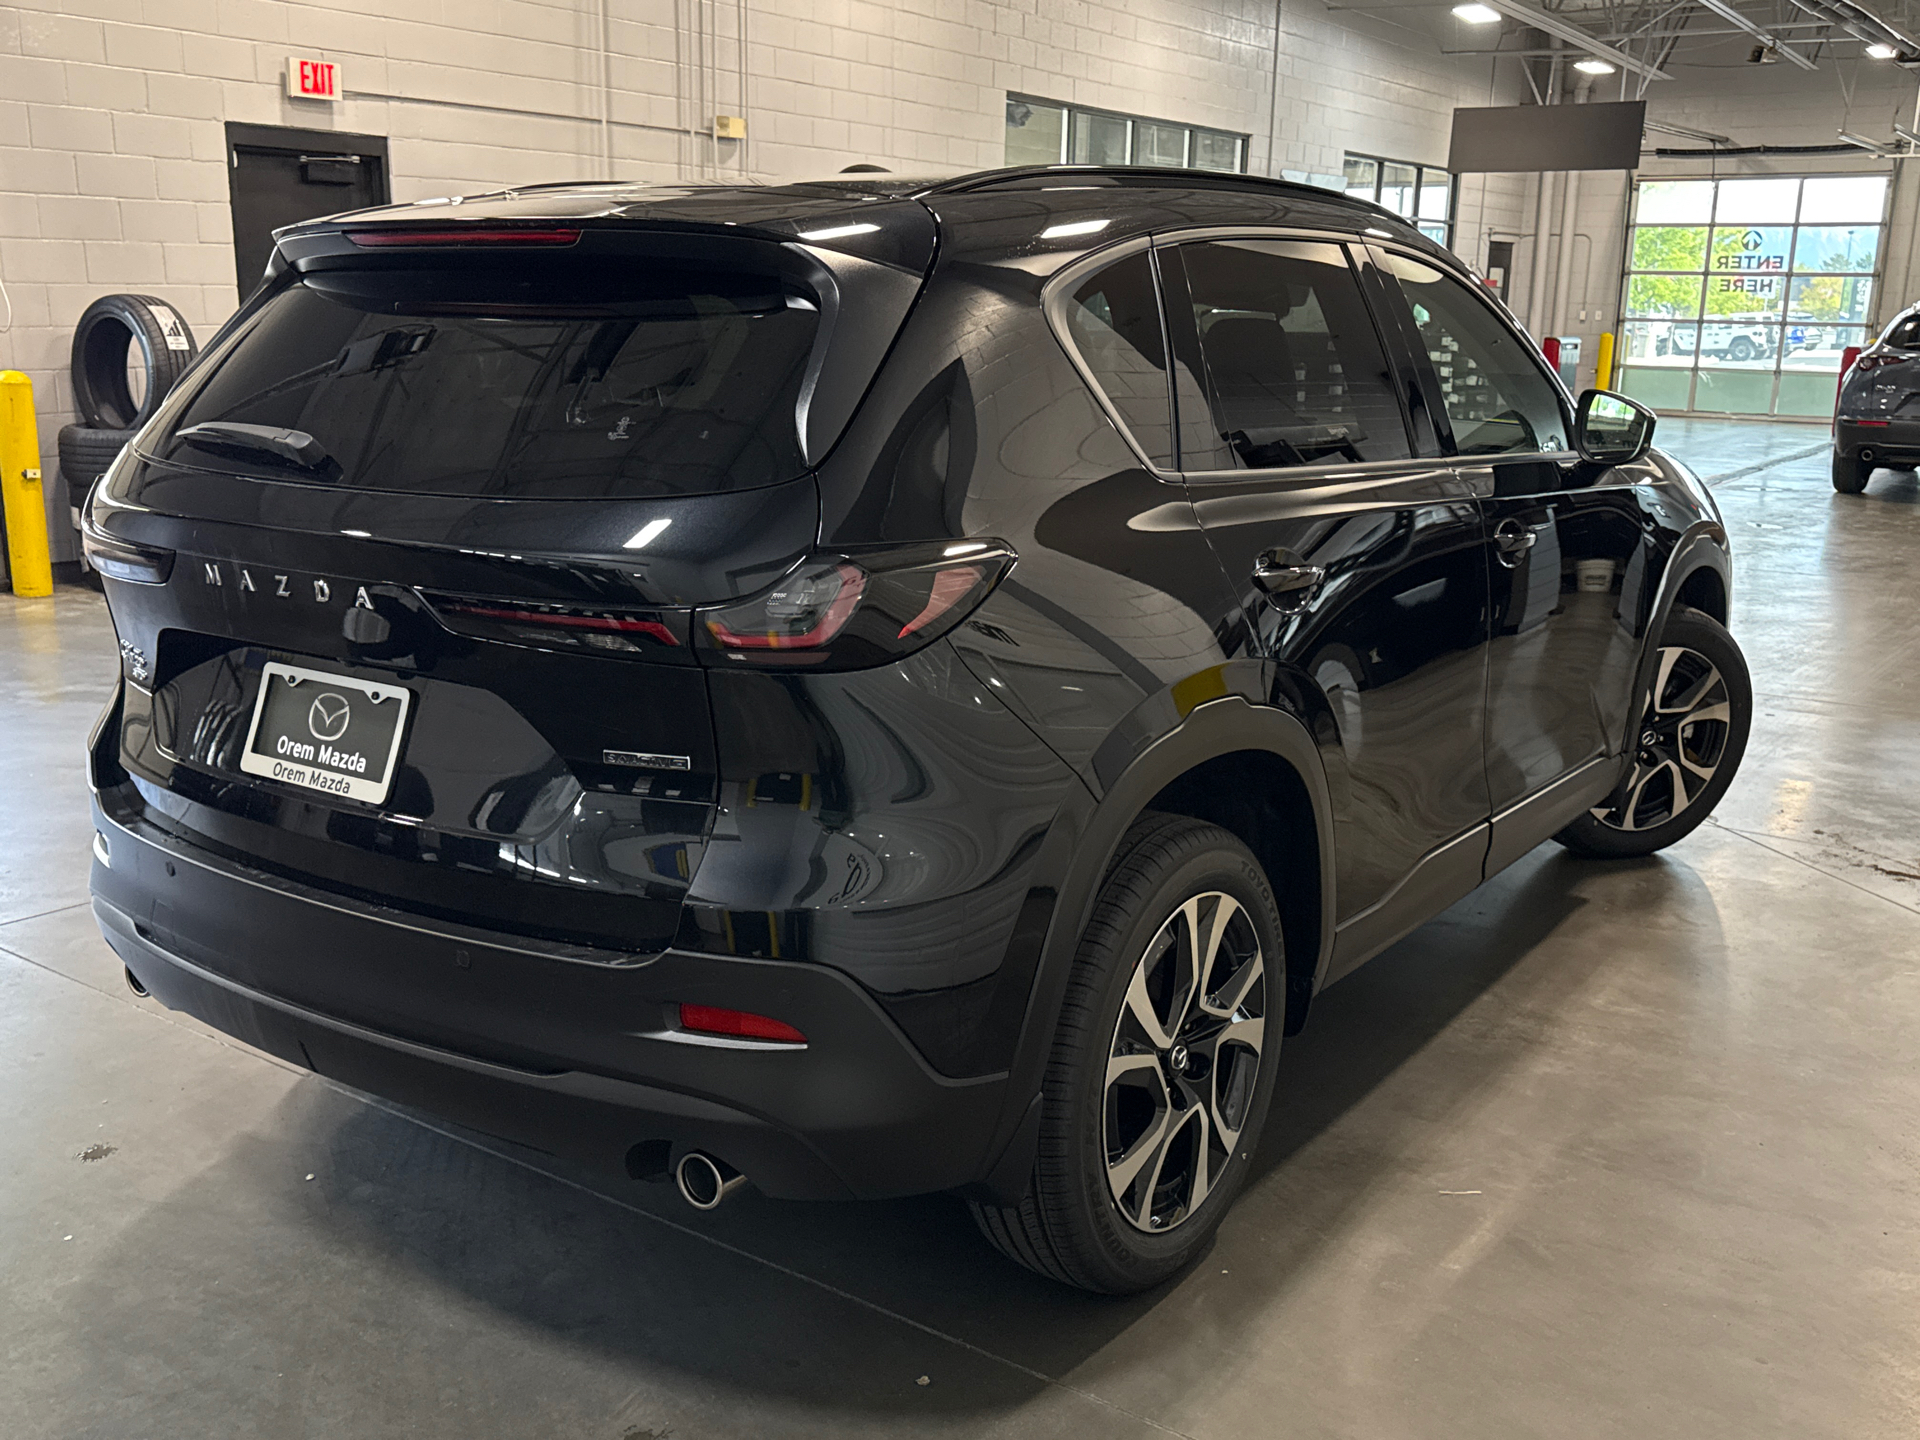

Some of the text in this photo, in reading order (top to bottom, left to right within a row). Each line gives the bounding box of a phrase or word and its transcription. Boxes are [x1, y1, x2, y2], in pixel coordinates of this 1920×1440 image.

[299, 60, 334, 96] EXIT
[204, 563, 374, 610] MAZDA
[276, 735, 367, 773] Orem Mazda
[272, 761, 351, 794] Orem Mazda
[1241, 860, 1270, 903] TOYO
